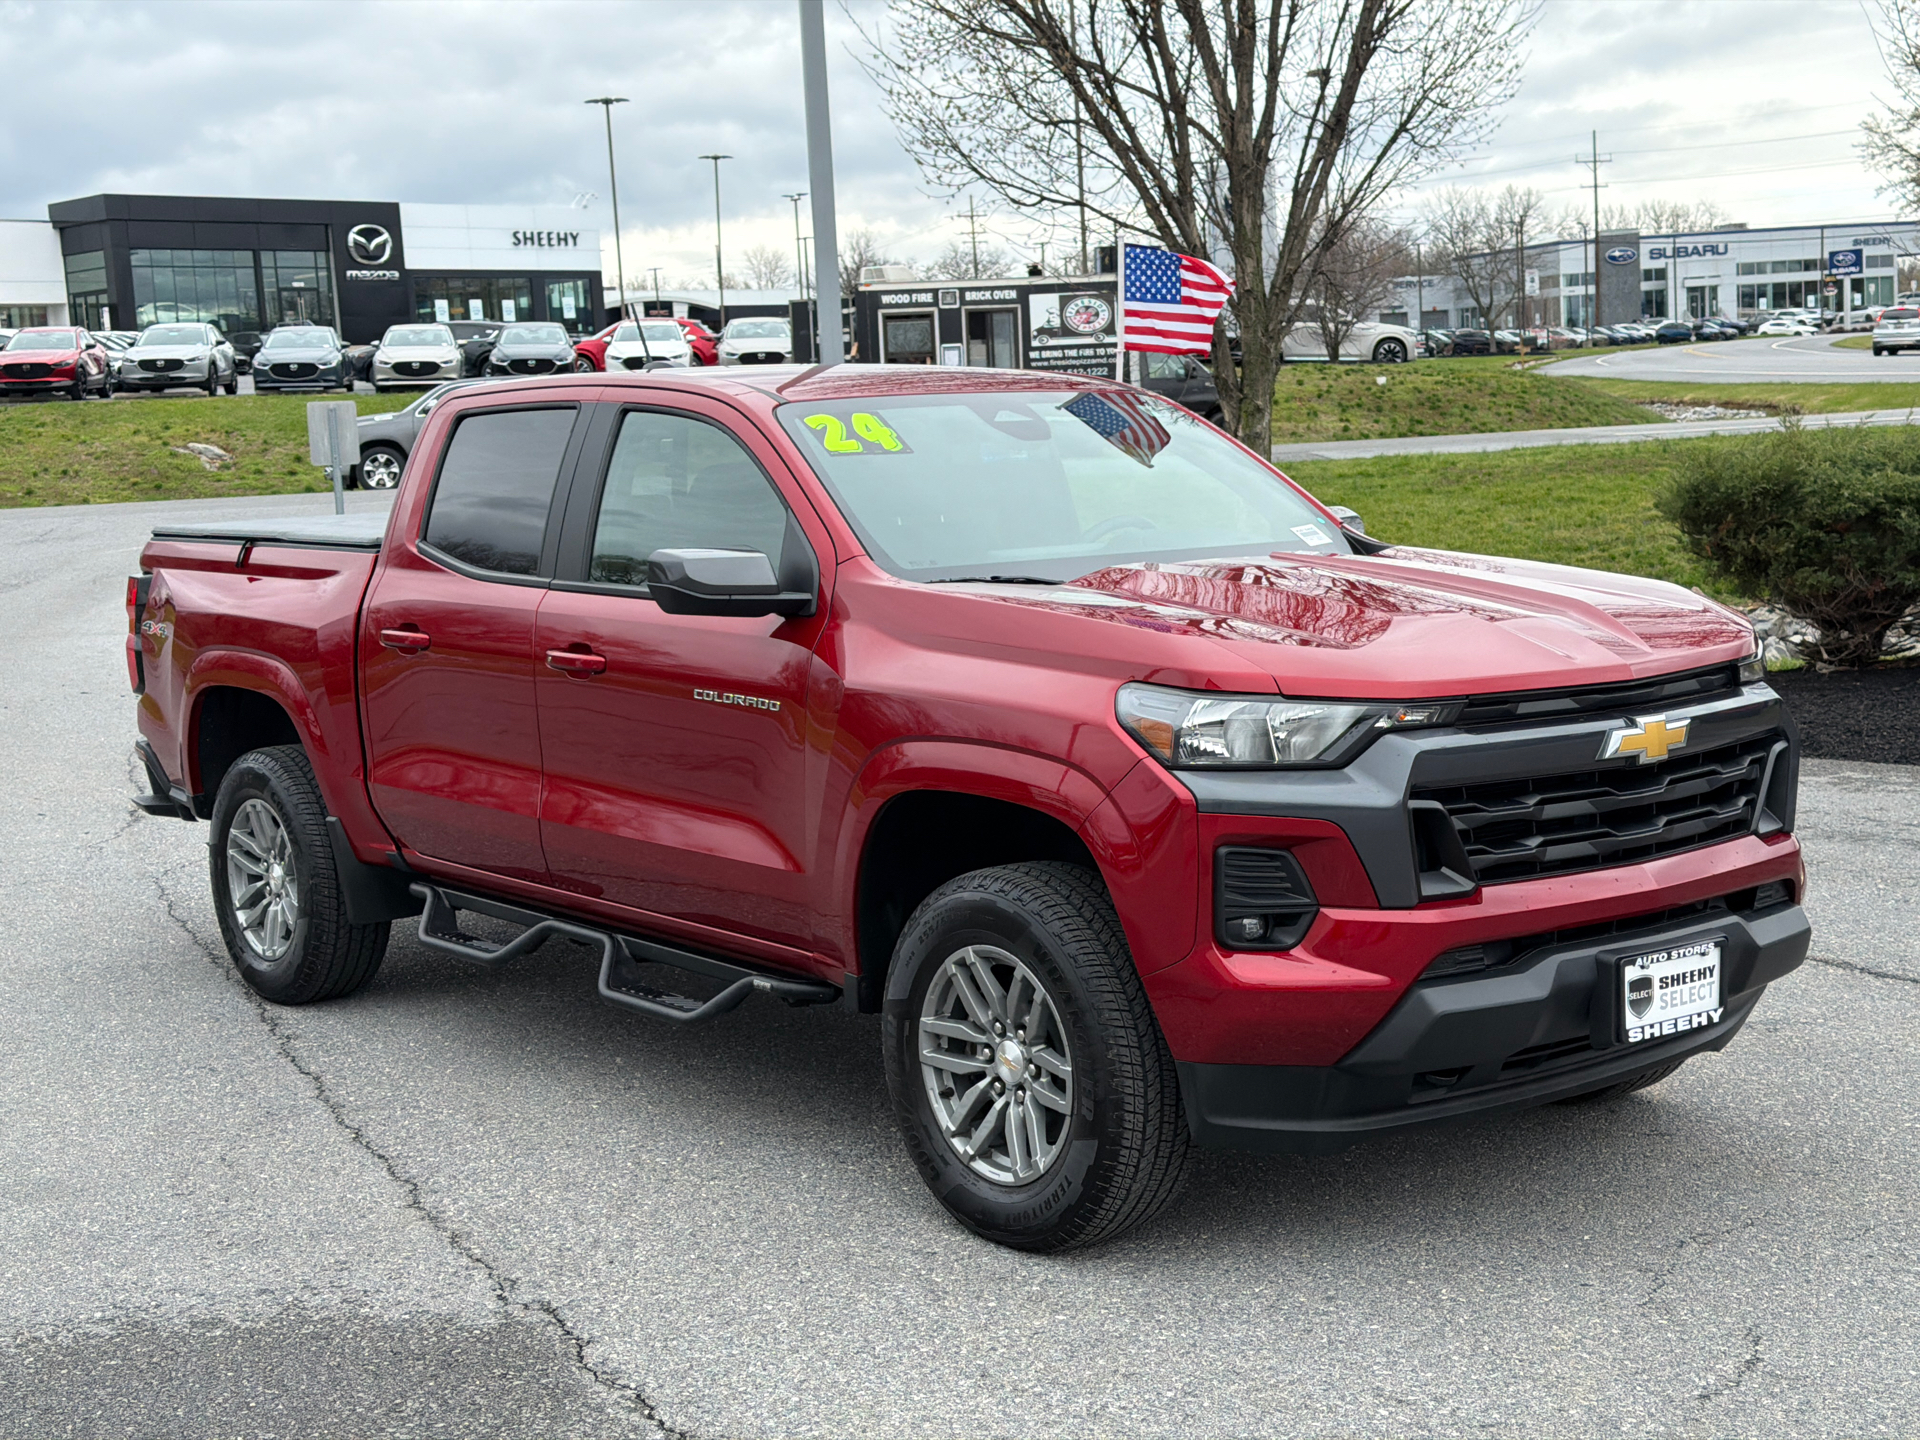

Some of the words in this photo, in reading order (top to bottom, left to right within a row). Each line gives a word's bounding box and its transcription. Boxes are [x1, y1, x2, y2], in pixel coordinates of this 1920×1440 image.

[512, 230, 580, 247] SHEEHY
[1852, 236, 1891, 247] SHEEHY
[1649, 243, 1729, 260] SUBARU
[1830, 265, 1860, 275] SUBARU
[1393, 278, 1434, 289] SERVCE
[881, 294, 910, 304] WOOD
[911, 293, 934, 303] FIRE
[965, 290, 992, 301] BRICK
[993, 289, 1017, 300] OVEN
[1028, 351, 1040, 359] WE
[1041, 349, 1063, 359] BRING
[1063, 348, 1078, 358] THE
[1079, 347, 1095, 357] FIRE
[1095, 347, 1106, 356] TO
[1106, 347, 1117, 356] YO
[1030, 357, 1117, 367] www.firesidepizzamd.co
[804, 413, 903, 452] 24
[693, 688, 781, 711] COLORADO
[1634, 952, 1668, 968] AUTO
[1670, 942, 1716, 960] STORES
[1659, 964, 1717, 990] SHEEHY
[1629, 989, 1653, 1001] SELECT
[1660, 981, 1716, 1011] SELECT
[1628, 1006, 1725, 1043] SHEEHY
[1006, 1174, 1073, 1225] TERRITORY
